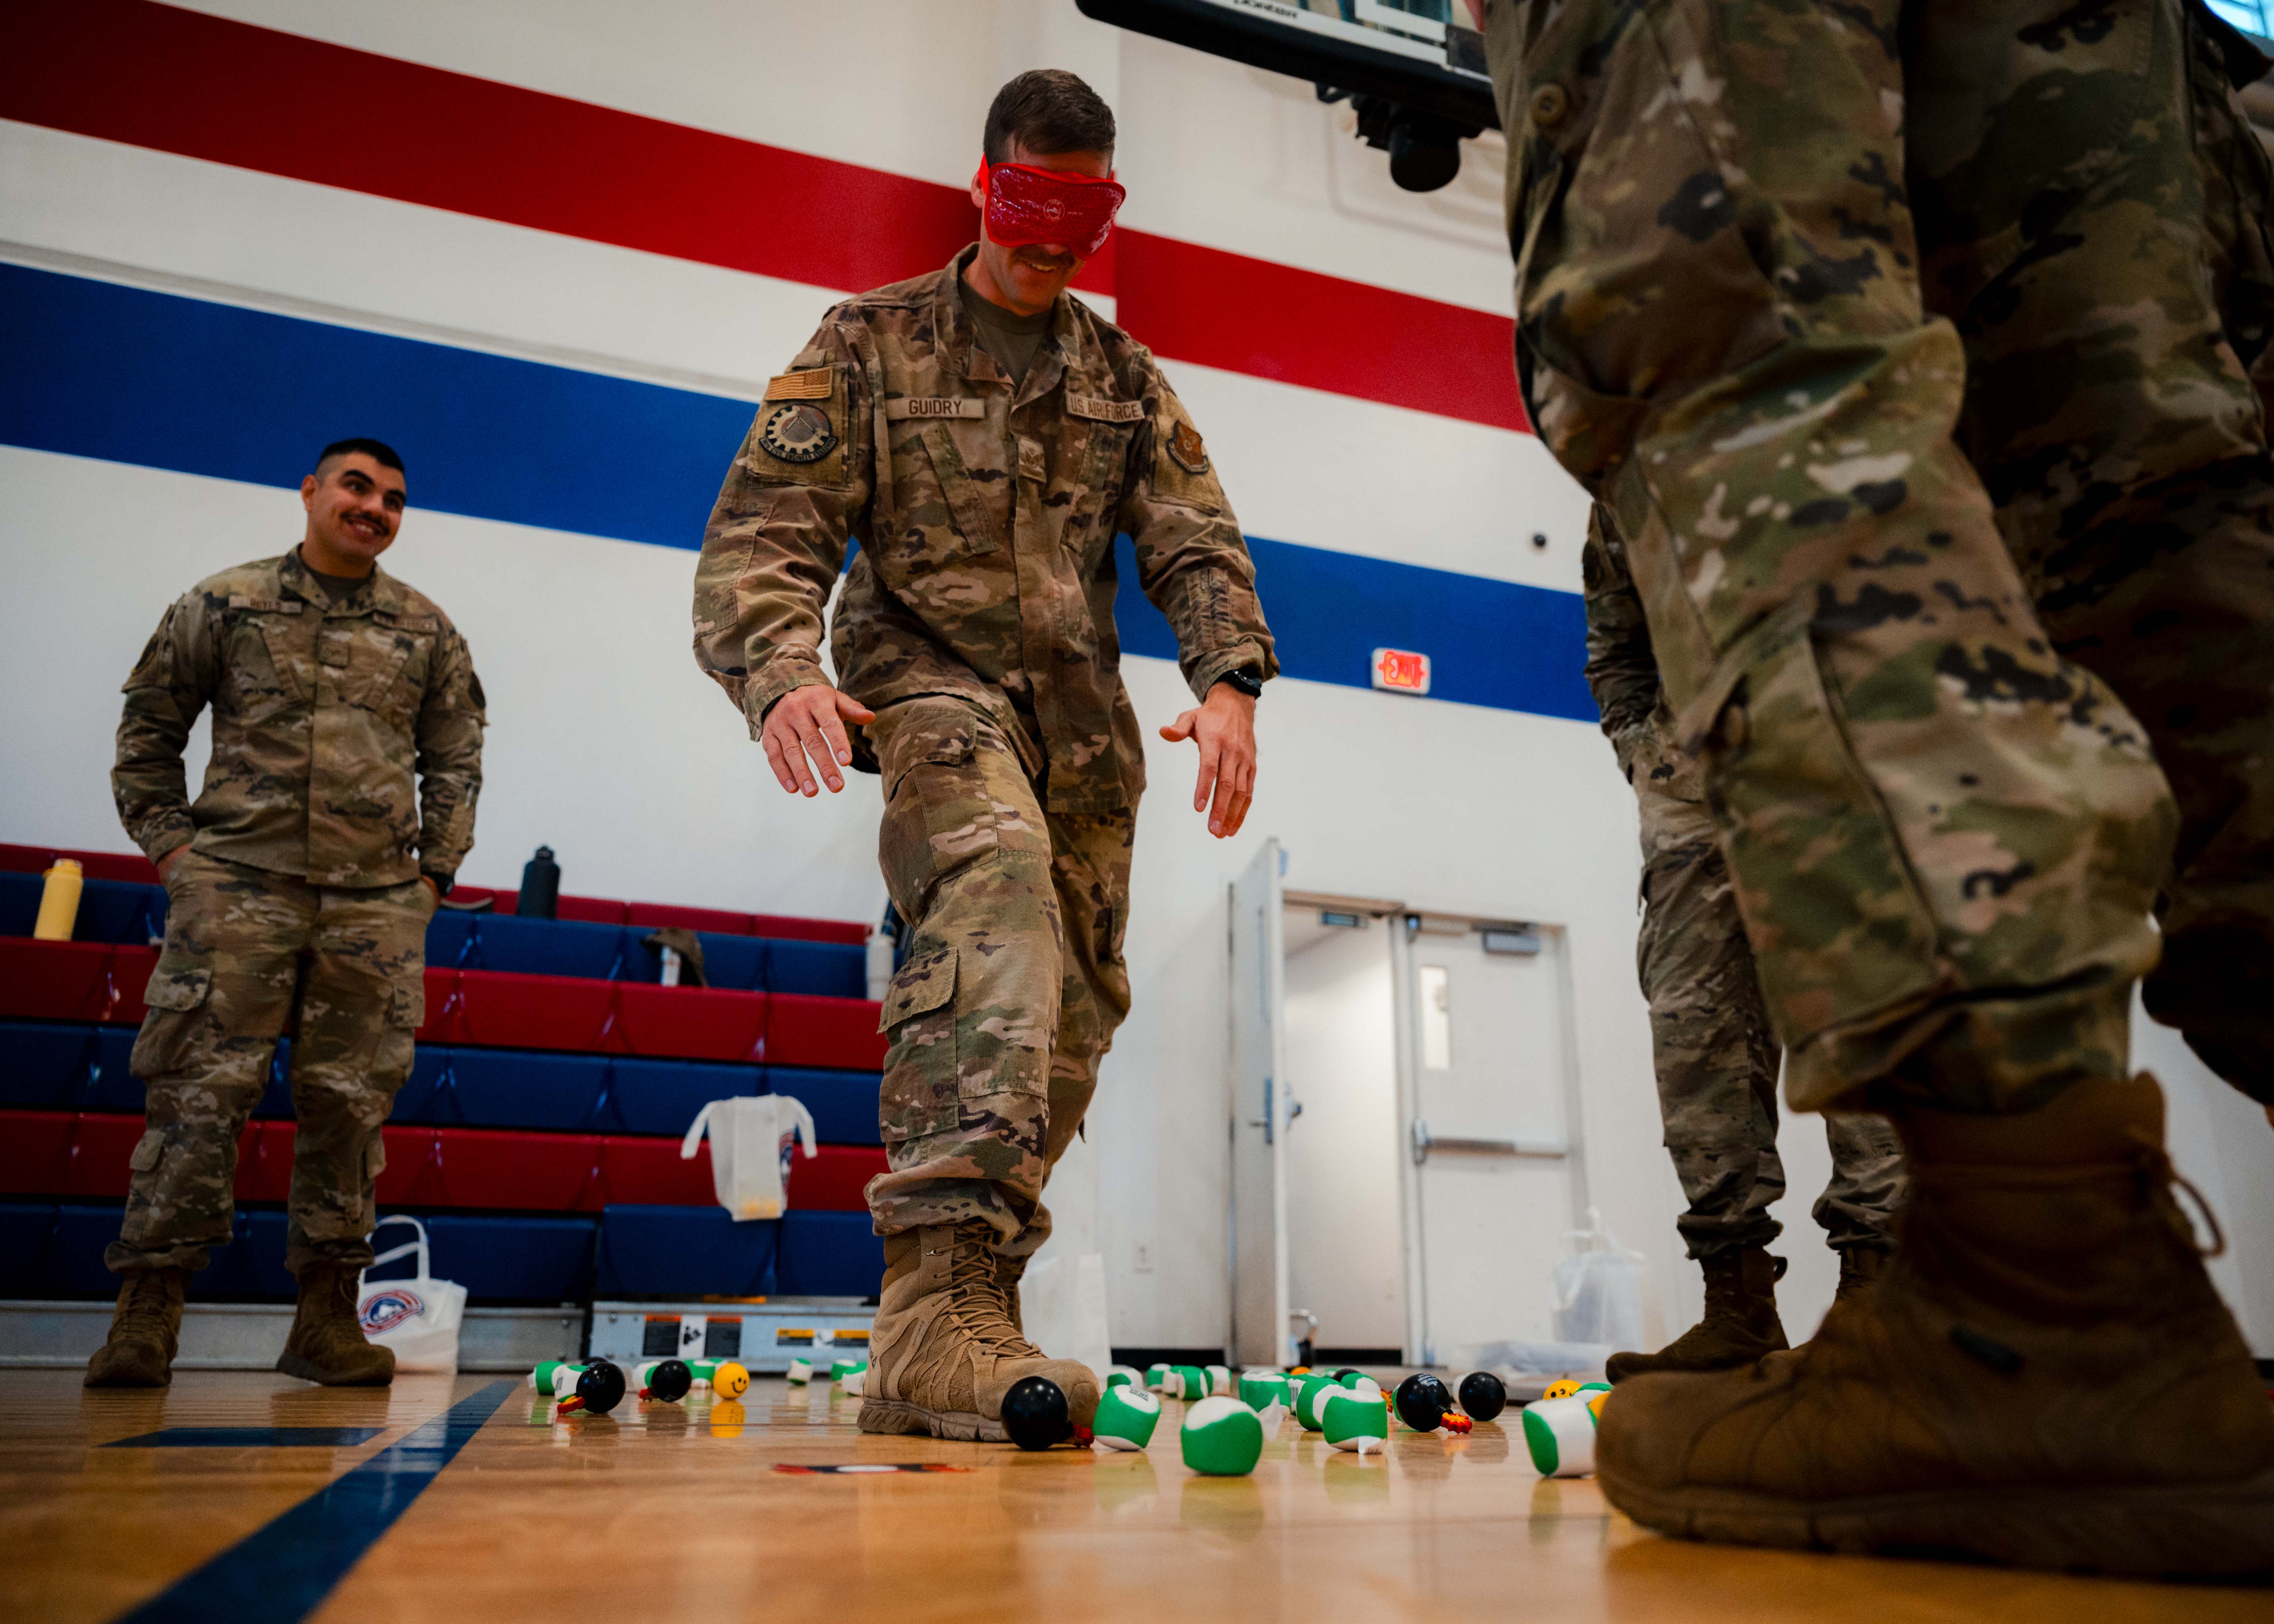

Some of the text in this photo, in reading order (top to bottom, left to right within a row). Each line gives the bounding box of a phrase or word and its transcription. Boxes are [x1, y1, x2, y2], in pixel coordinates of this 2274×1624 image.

[909, 400, 962, 414] GUIDRY
[1071, 397, 1139, 420] US AIR FORCE
